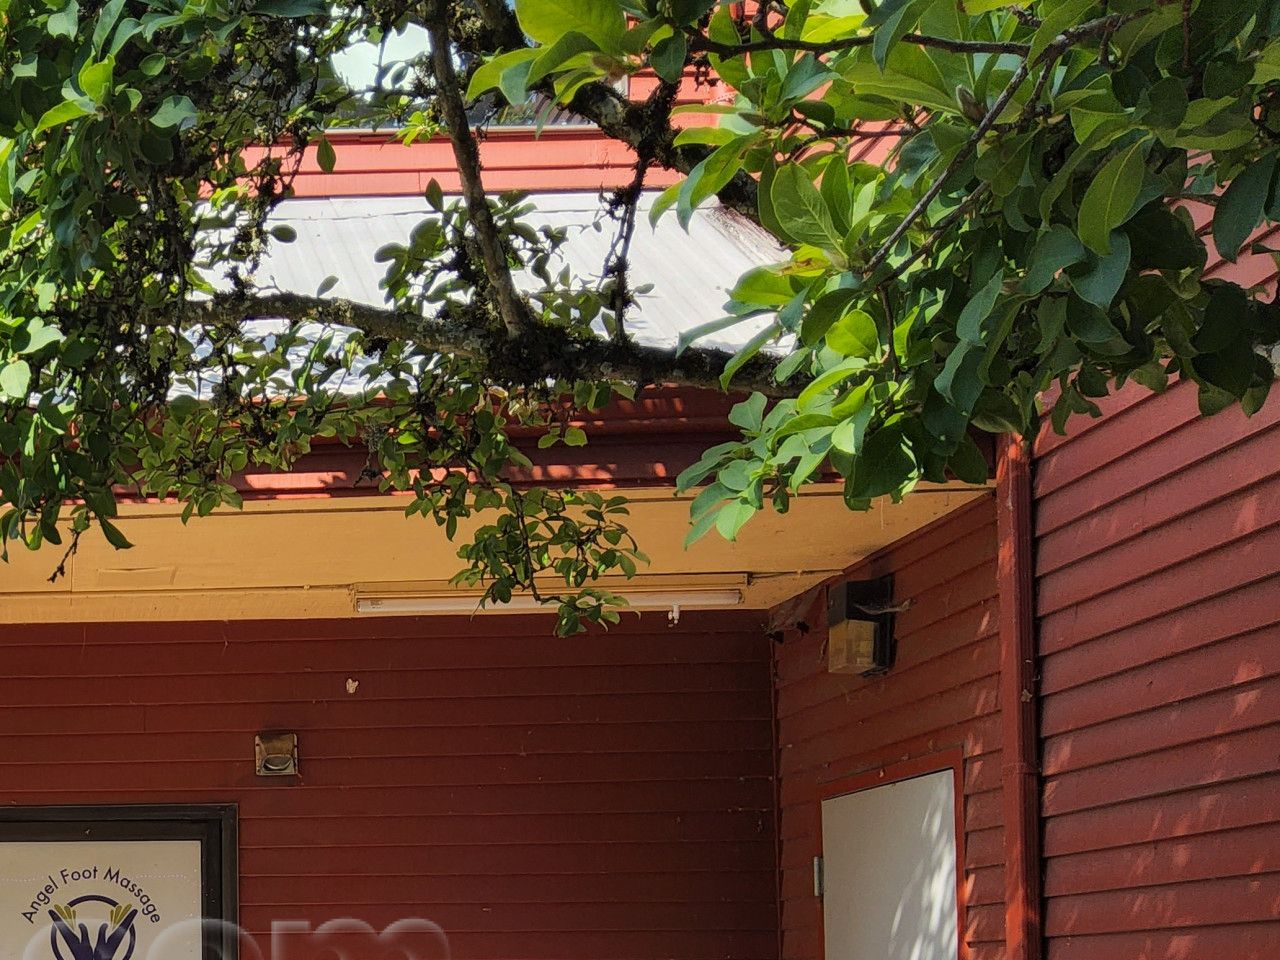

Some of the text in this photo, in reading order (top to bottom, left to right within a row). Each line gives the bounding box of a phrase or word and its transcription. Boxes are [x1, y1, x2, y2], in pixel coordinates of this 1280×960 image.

[21, 865, 161, 924] Angel Foot Massage
